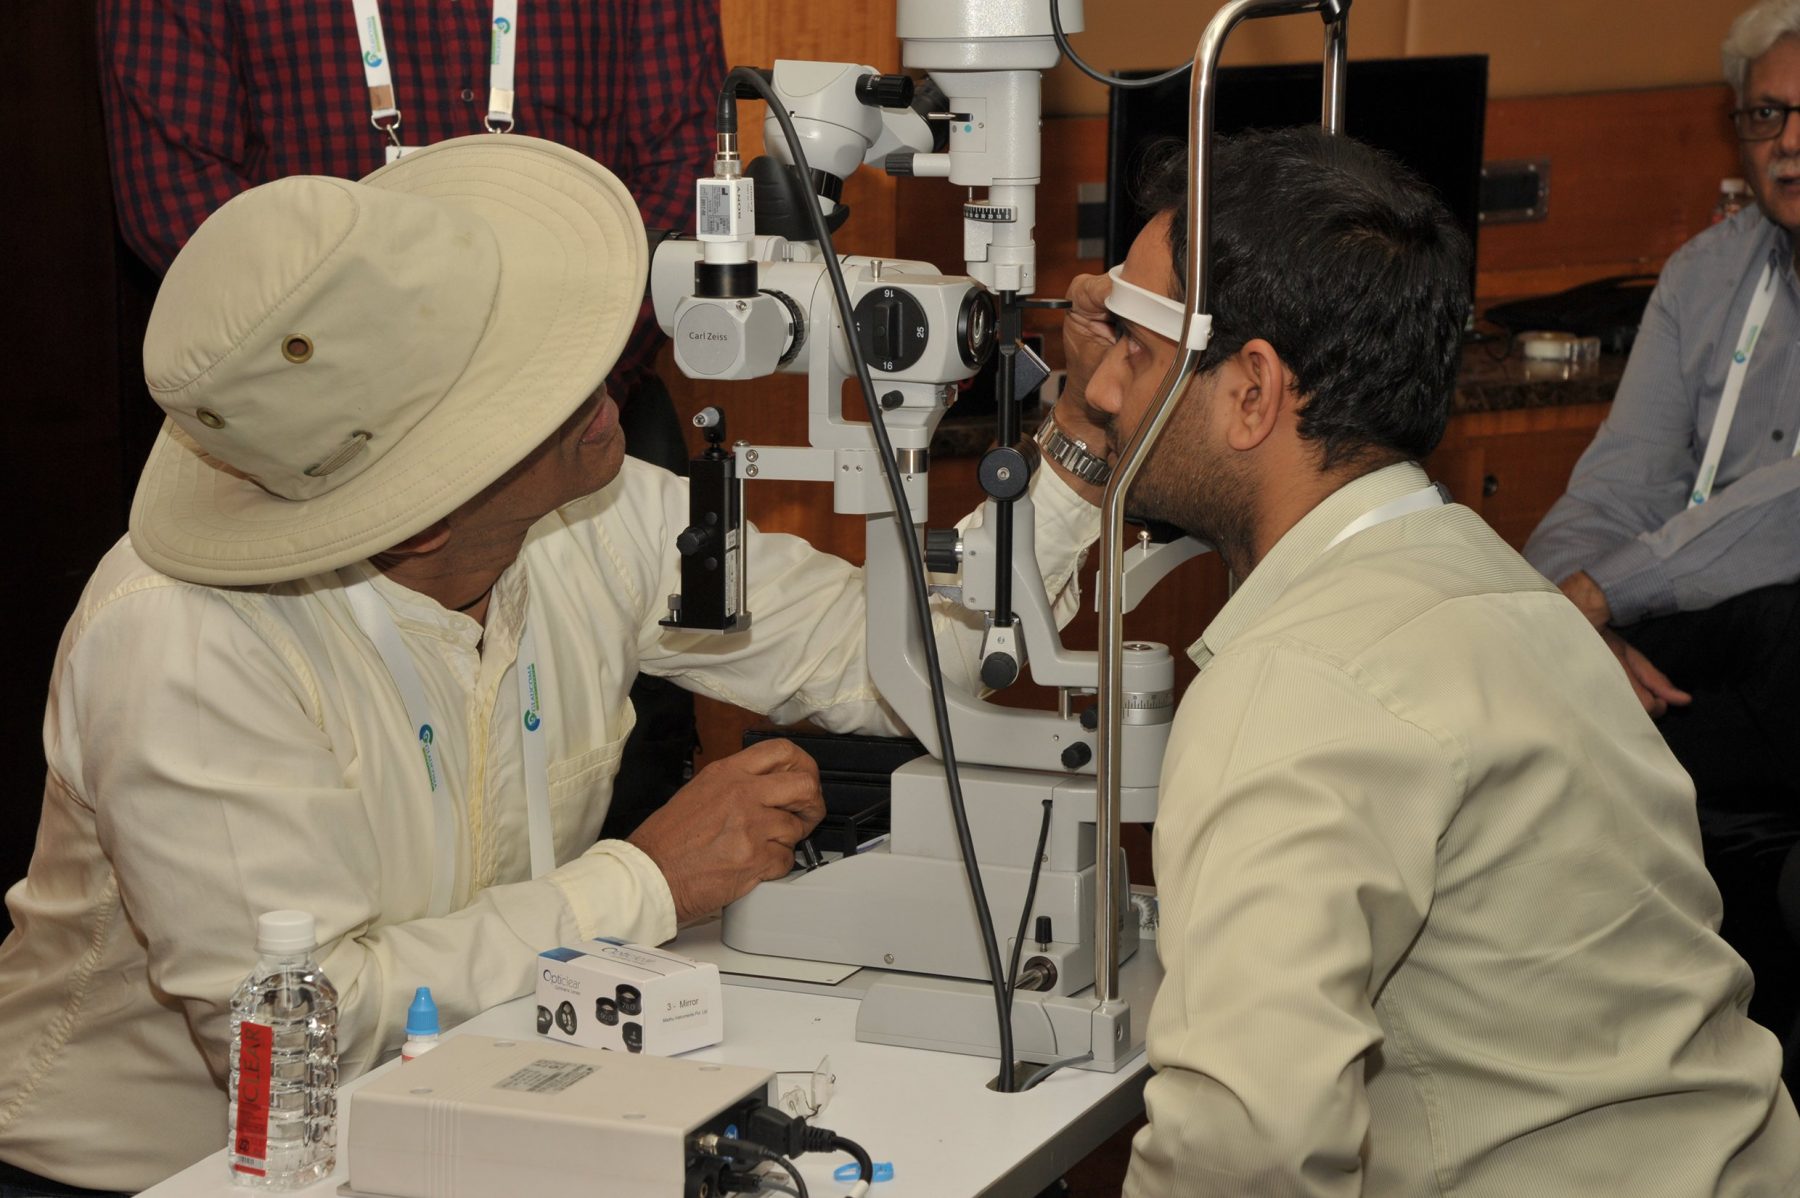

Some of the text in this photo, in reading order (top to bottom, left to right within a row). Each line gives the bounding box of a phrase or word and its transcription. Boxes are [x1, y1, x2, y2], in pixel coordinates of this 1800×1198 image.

[884, 289, 895, 298] 16
[688, 331, 728, 341] Carl Zeiss
[916, 326, 925, 338] 25
[883, 361, 893, 370] 16
[543, 969, 580, 989] Opticlear
[679, 998, 699, 1009] Mirror
[243, 1027, 261, 1102] CLEAR
